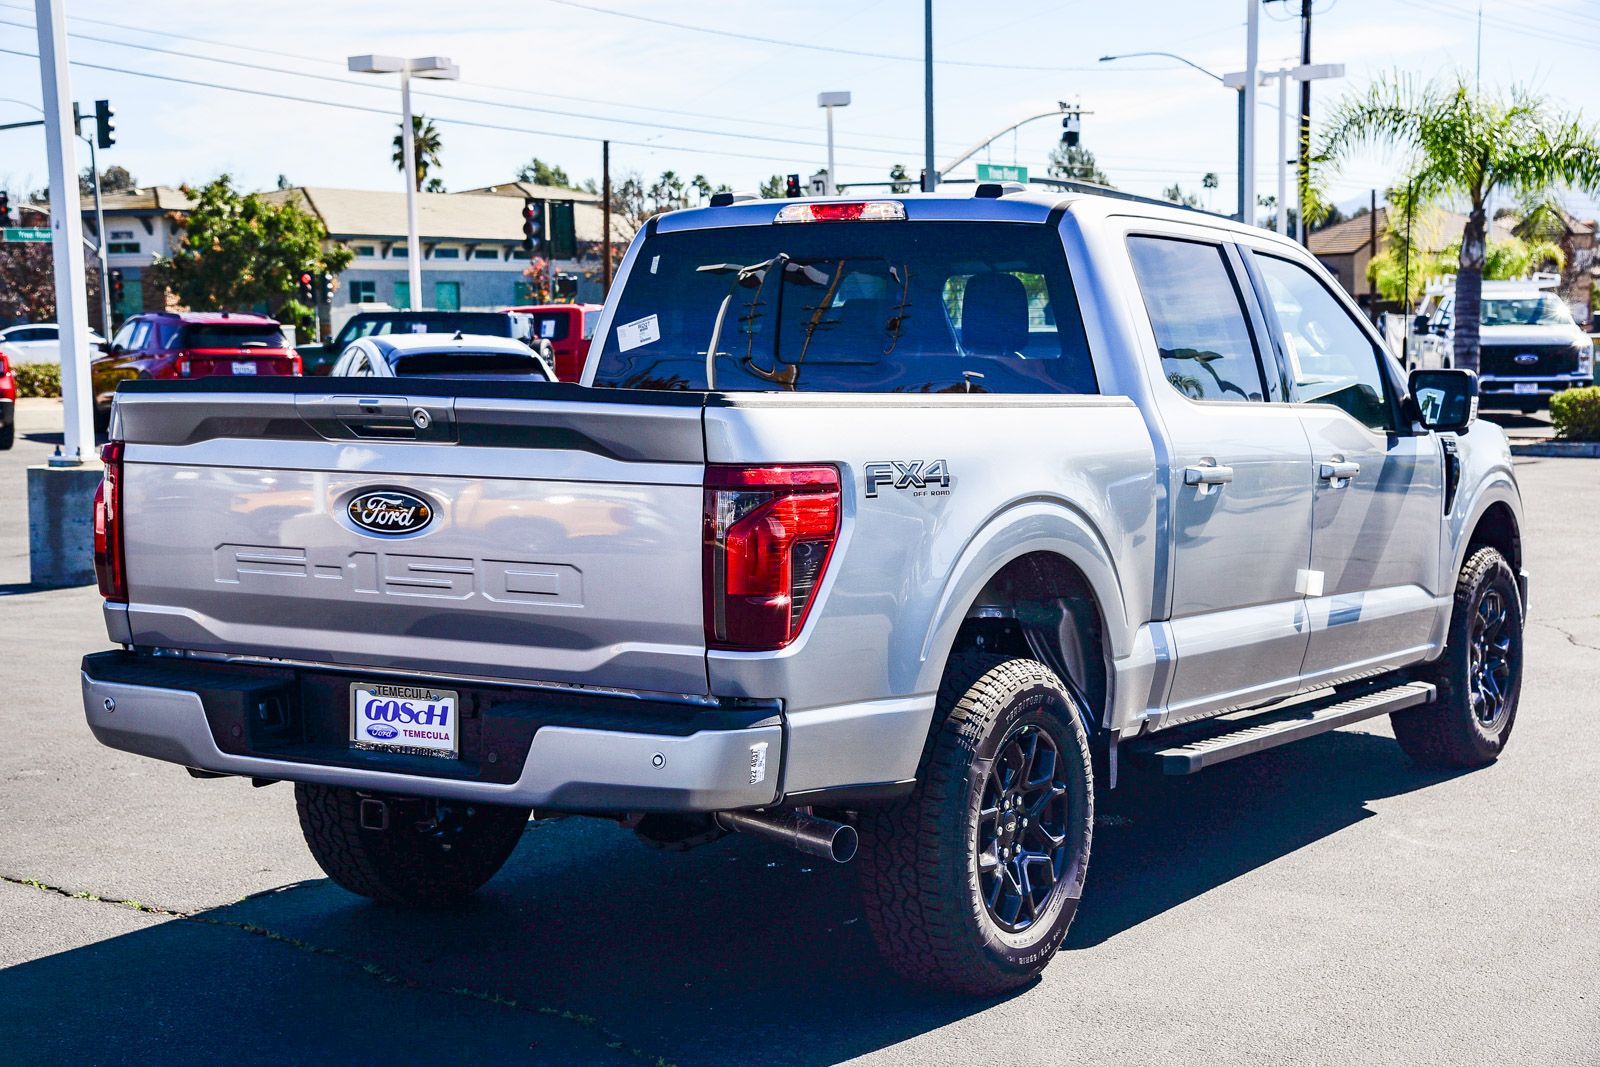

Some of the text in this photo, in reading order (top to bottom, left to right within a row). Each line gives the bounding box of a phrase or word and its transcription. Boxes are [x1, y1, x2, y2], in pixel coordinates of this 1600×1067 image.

[863, 459, 950, 498] FX4
[362, 496, 415, 527] Ford
[215, 543, 584, 608] F-150
[376, 685, 432, 700] TEMECULA
[371, 728, 450, 741] Ford TEMECULA
